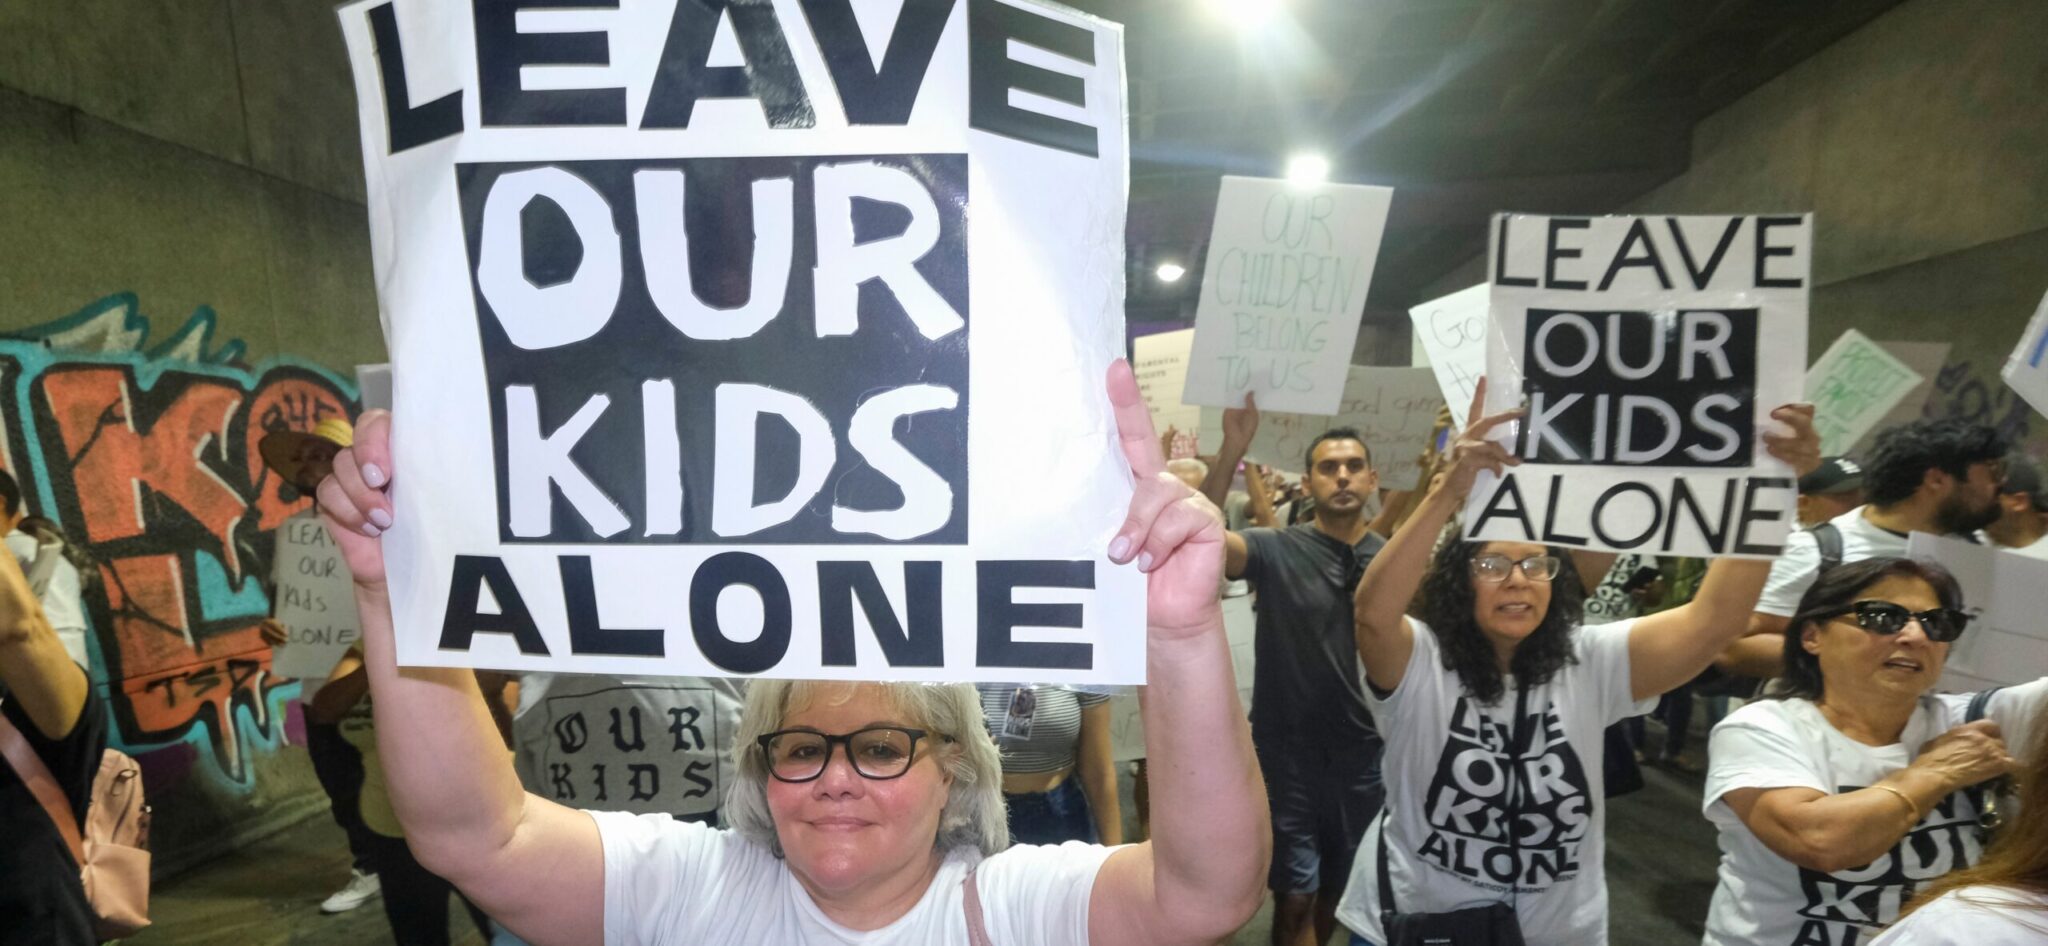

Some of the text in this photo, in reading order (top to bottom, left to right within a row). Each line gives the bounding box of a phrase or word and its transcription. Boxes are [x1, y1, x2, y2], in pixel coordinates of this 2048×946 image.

[364, 0, 1099, 158] LEAVE
[477, 160, 965, 350] OUR
[1262, 193, 1334, 249] OUR
[1494, 216, 1804, 292] LEAVE
[1215, 247, 1360, 315] CHILDREN
[1233, 311, 1328, 352] BELONG
[1532, 311, 1734, 381] OUR
[1218, 355, 1315, 393] TO US
[504, 378, 959, 541] KIDS
[1524, 391, 1742, 464] KIDS
[1467, 472, 1795, 555] ALONE
[298, 555, 340, 579] OUR
[288, 625, 355, 645] LONE
[438, 550, 1097, 674] ALONE
[554, 705, 706, 754] OUR
[550, 760, 714, 801] KIDS
